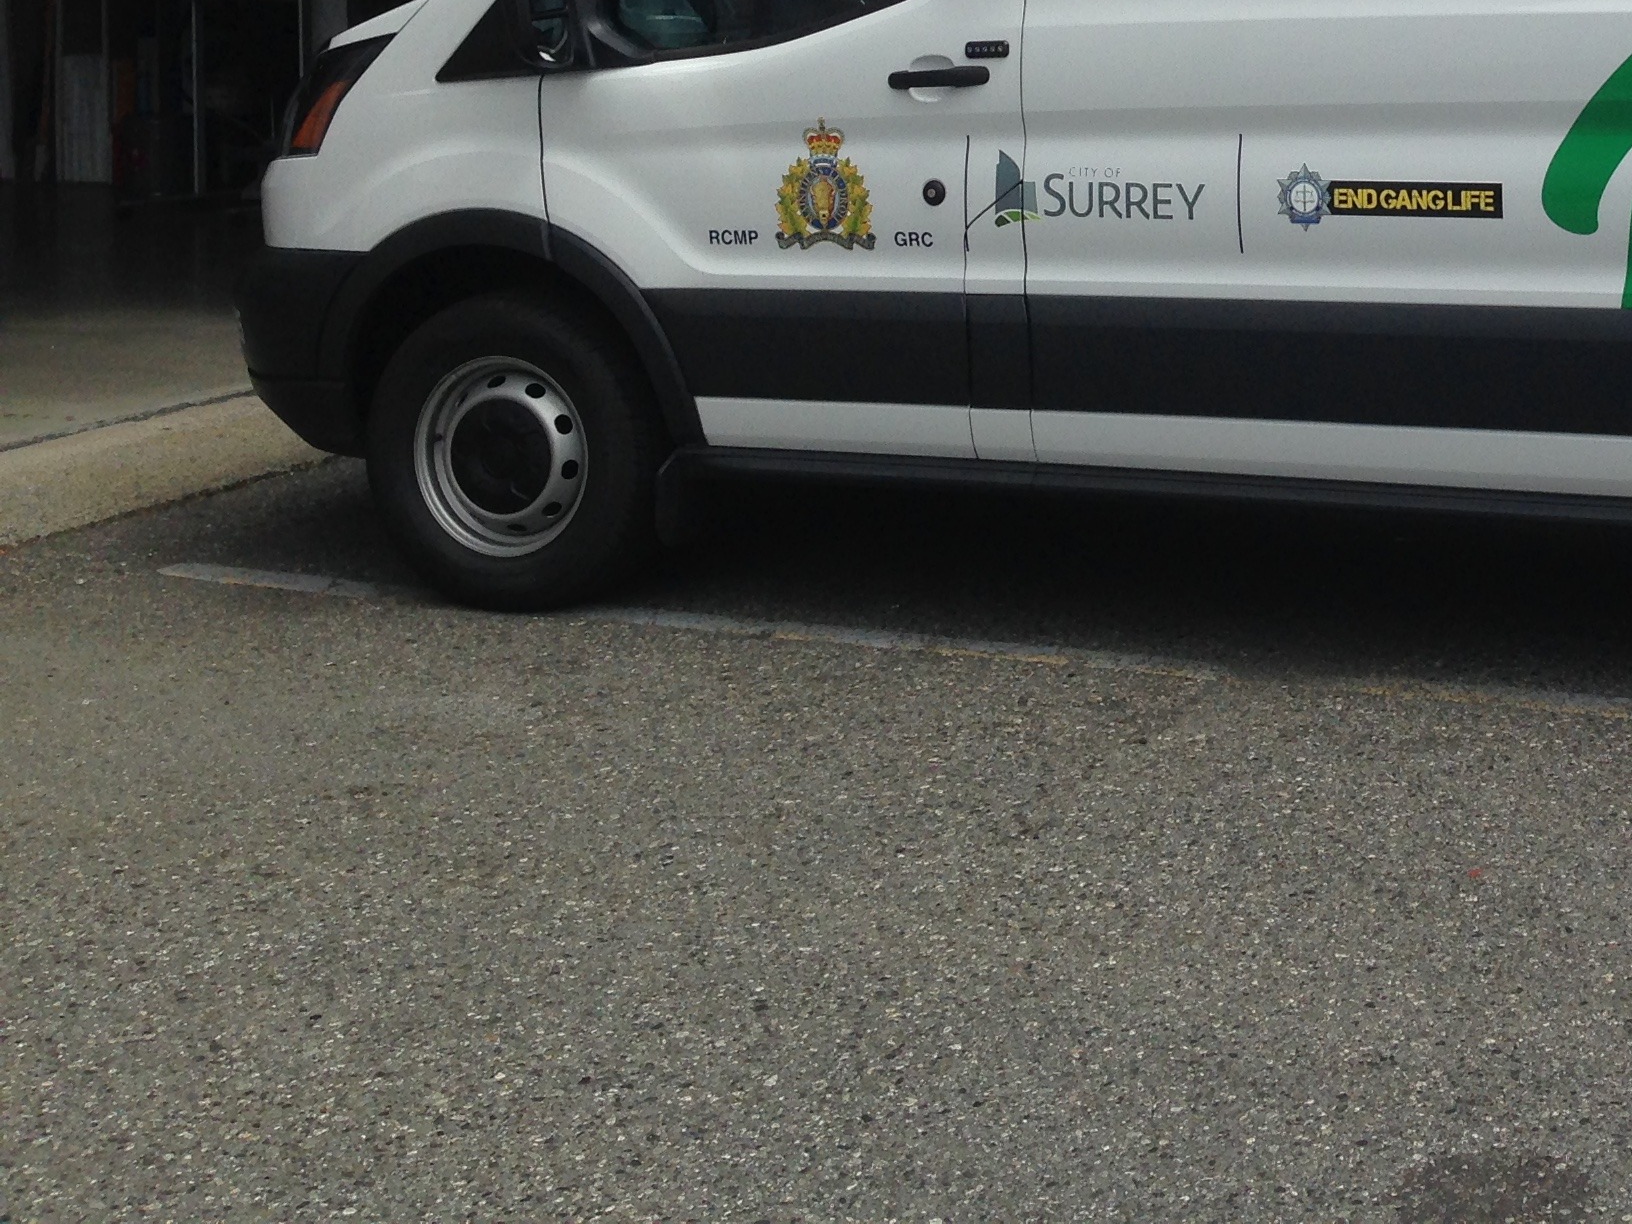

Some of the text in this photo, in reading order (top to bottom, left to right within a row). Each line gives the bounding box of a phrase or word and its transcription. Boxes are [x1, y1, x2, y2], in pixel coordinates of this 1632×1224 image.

[1068, 166, 1121, 179] CITY OF
[1043, 173, 1205, 220] SURREY
[1333, 188, 1378, 209] END
[1380, 189, 1445, 210] GANG
[1447, 190, 1495, 212] LIFE
[708, 229, 759, 246] RCMP
[894, 231, 934, 248] GRC
